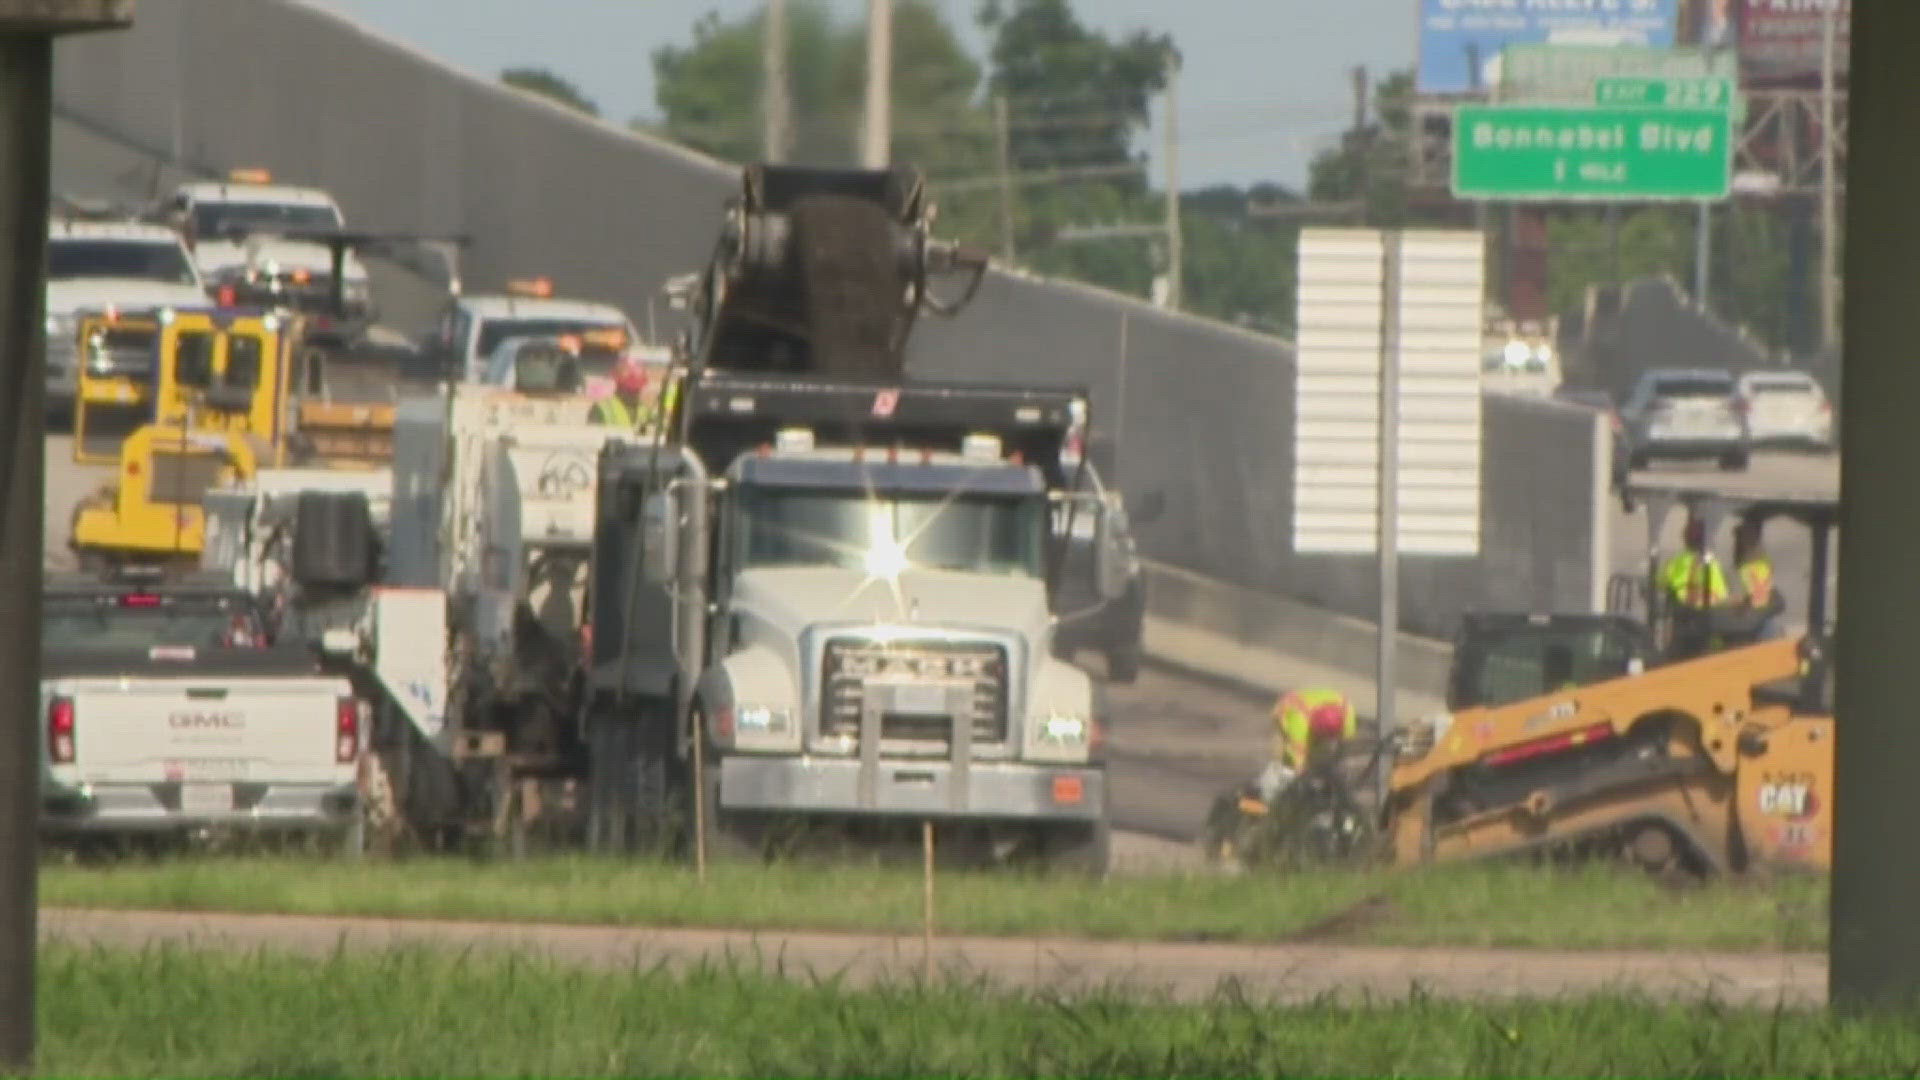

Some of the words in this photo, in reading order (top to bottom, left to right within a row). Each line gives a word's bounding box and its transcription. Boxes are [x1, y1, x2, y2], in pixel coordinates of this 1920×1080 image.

[1472, 122, 1625, 151] Bonnabel
[1639, 122, 1714, 152] Blvd
[167, 711, 246, 730] GMC
[1759, 783, 1808, 815] CAT
